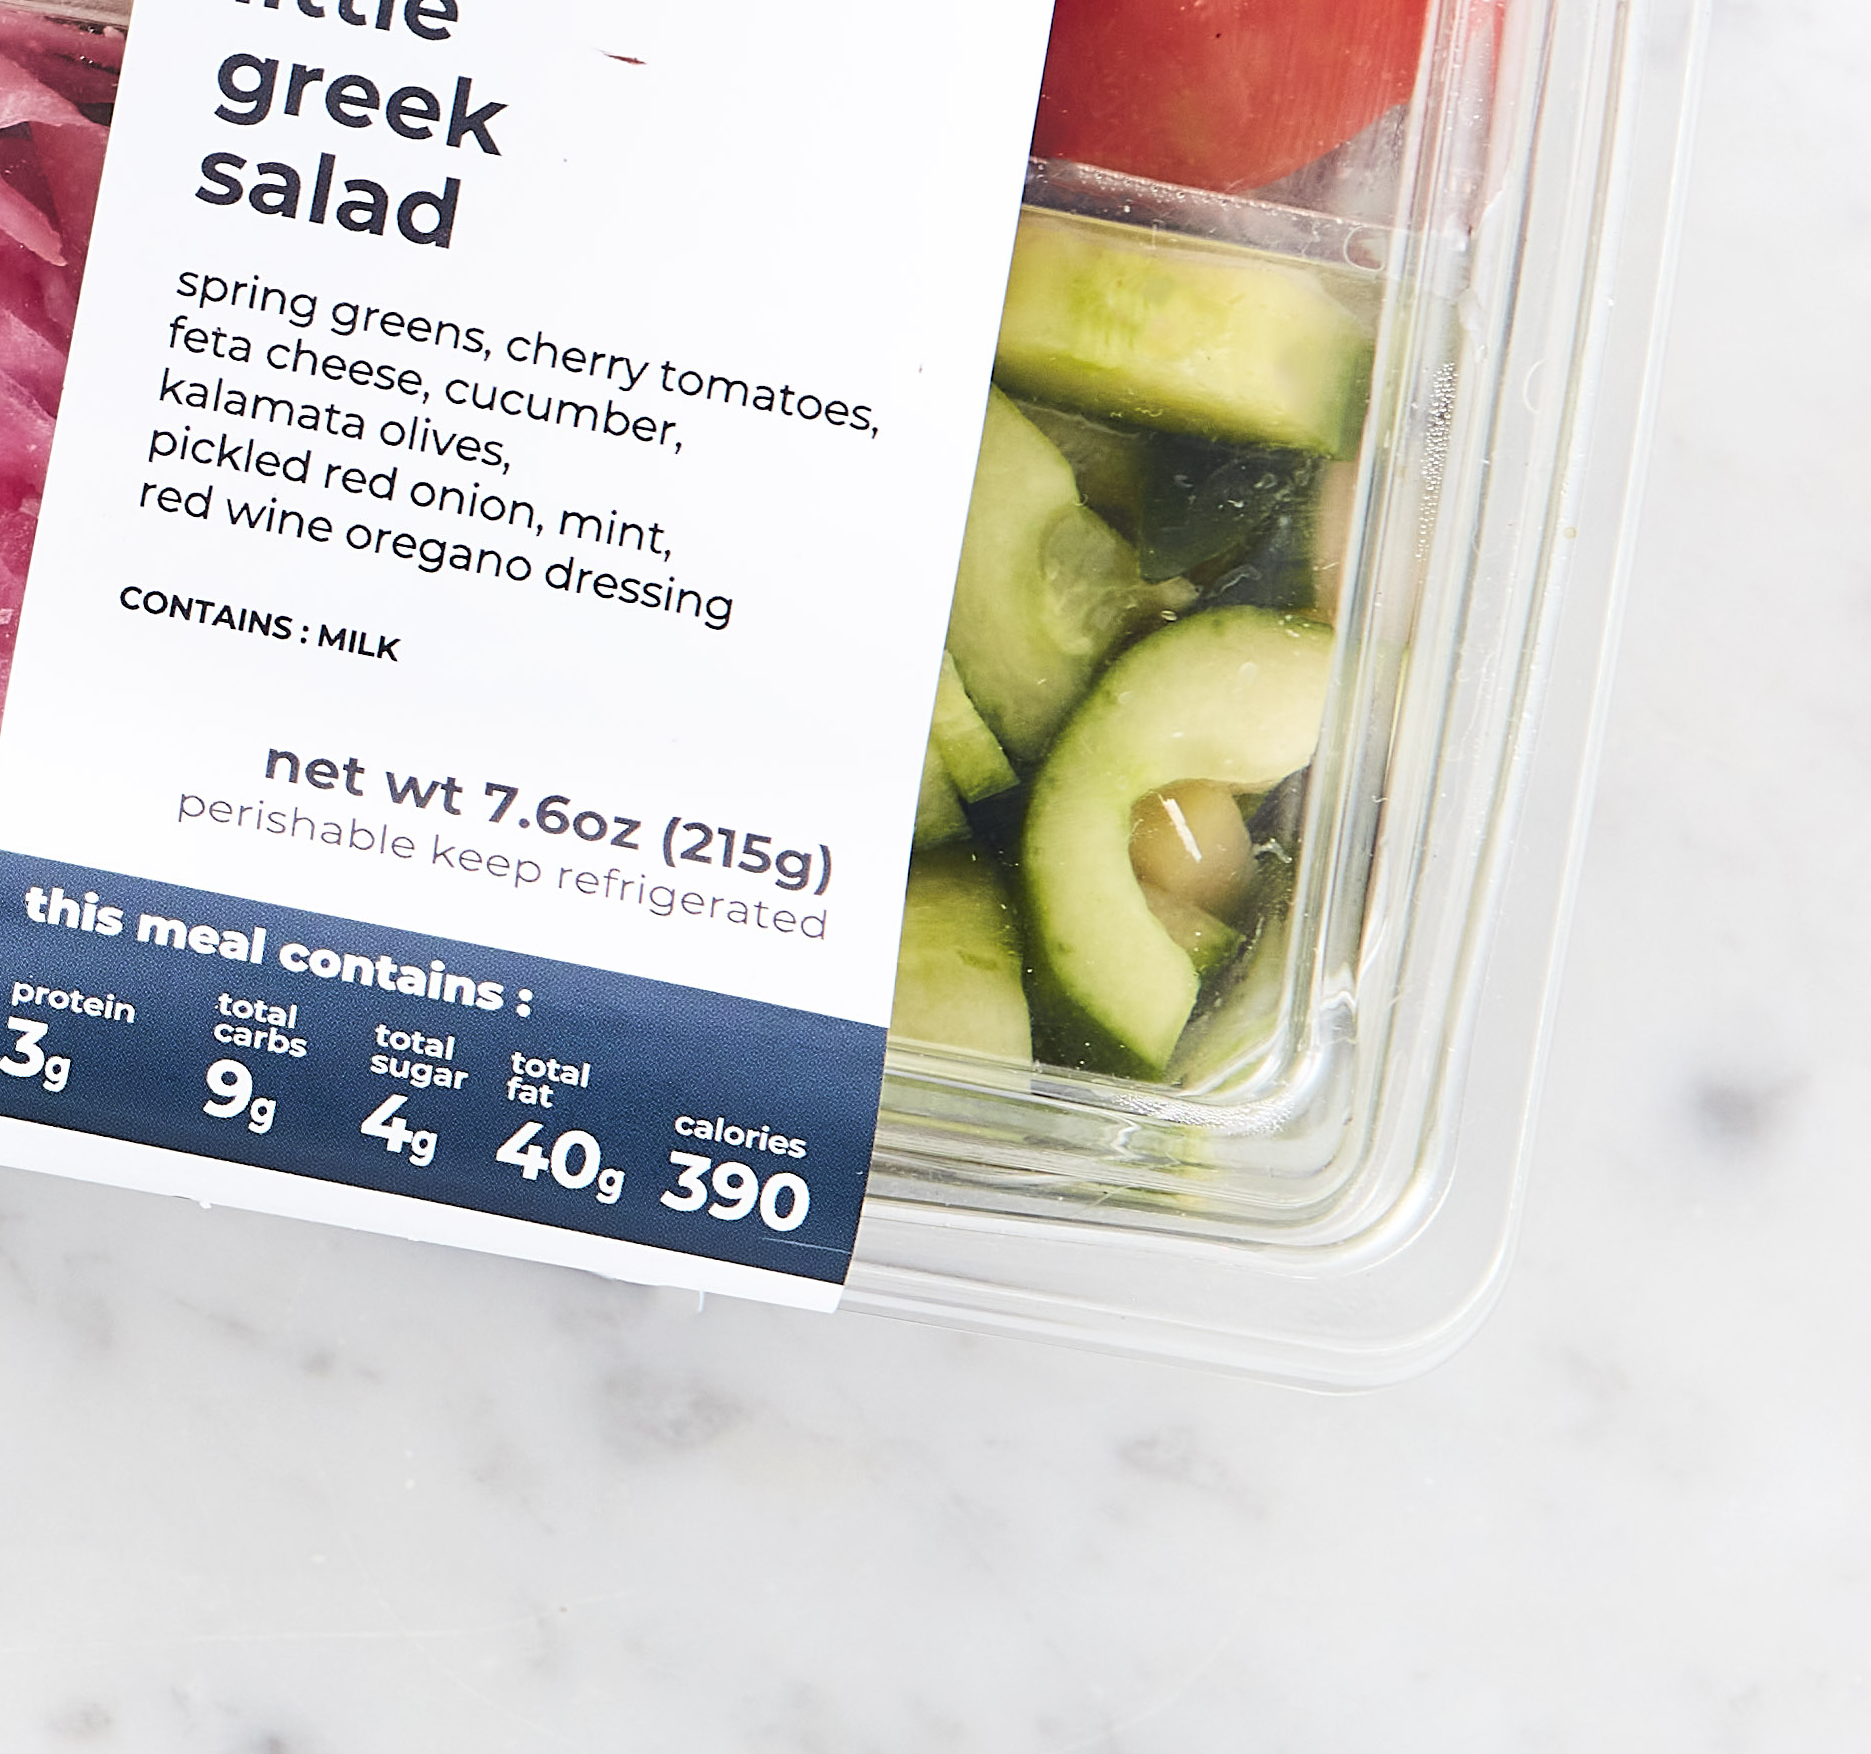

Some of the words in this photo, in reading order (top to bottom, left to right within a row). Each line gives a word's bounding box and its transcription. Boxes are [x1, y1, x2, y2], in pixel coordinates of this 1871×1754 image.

[214, 53, 508, 156] greek
[195, 152, 461, 249] salad
[170, 315, 251, 362] feta
[267, 339, 429, 404] cheese,
[446, 379, 681, 454] cucumber,
[177, 272, 317, 328] spring
[331, 302, 491, 361] greens,
[507, 331, 649, 391] cherry
[661, 361, 878, 439] tomatoes,
[160, 368, 364, 439] kalamata
[380, 416, 509, 475] olives,
[149, 430, 311, 483] pickled
[325, 464, 397, 501] red
[411, 482, 543, 536] onion,
[559, 511, 670, 562] mint,
[140, 483, 213, 519] red
[227, 499, 332, 542] wine
[346, 524, 531, 581] oregano
[546, 557, 732, 630] dressing
[120, 586, 292, 639] CONTAINS
[318, 624, 400, 662] MILK
[266, 749, 365, 796] net
[386, 772, 462, 815] wt
[485, 782, 641, 849] 7.6oz
[663, 817, 831, 895] (215g)
[179, 794, 414, 858] perishable
[433, 835, 540, 887] keep
[559, 868, 826, 939] refrigerated
[25, 886, 124, 938] this
[135, 913, 266, 965] meal
[279, 942, 504, 1011] contains
[12, 981, 135, 1023] protein
[214, 1024, 307, 1057] carbs
[218, 993, 297, 1029] total
[375, 1024, 455, 1060] total
[203, 1059, 276, 1134] 9g
[370, 1055, 468, 1089] sugar
[507, 1076, 553, 1108] fat
[511, 1052, 590, 1088] total
[361, 1094, 437, 1166] 4g
[496, 1122, 625, 1204] 40g
[675, 1116, 806, 1158] calories
[660, 1151, 810, 1231] 390
